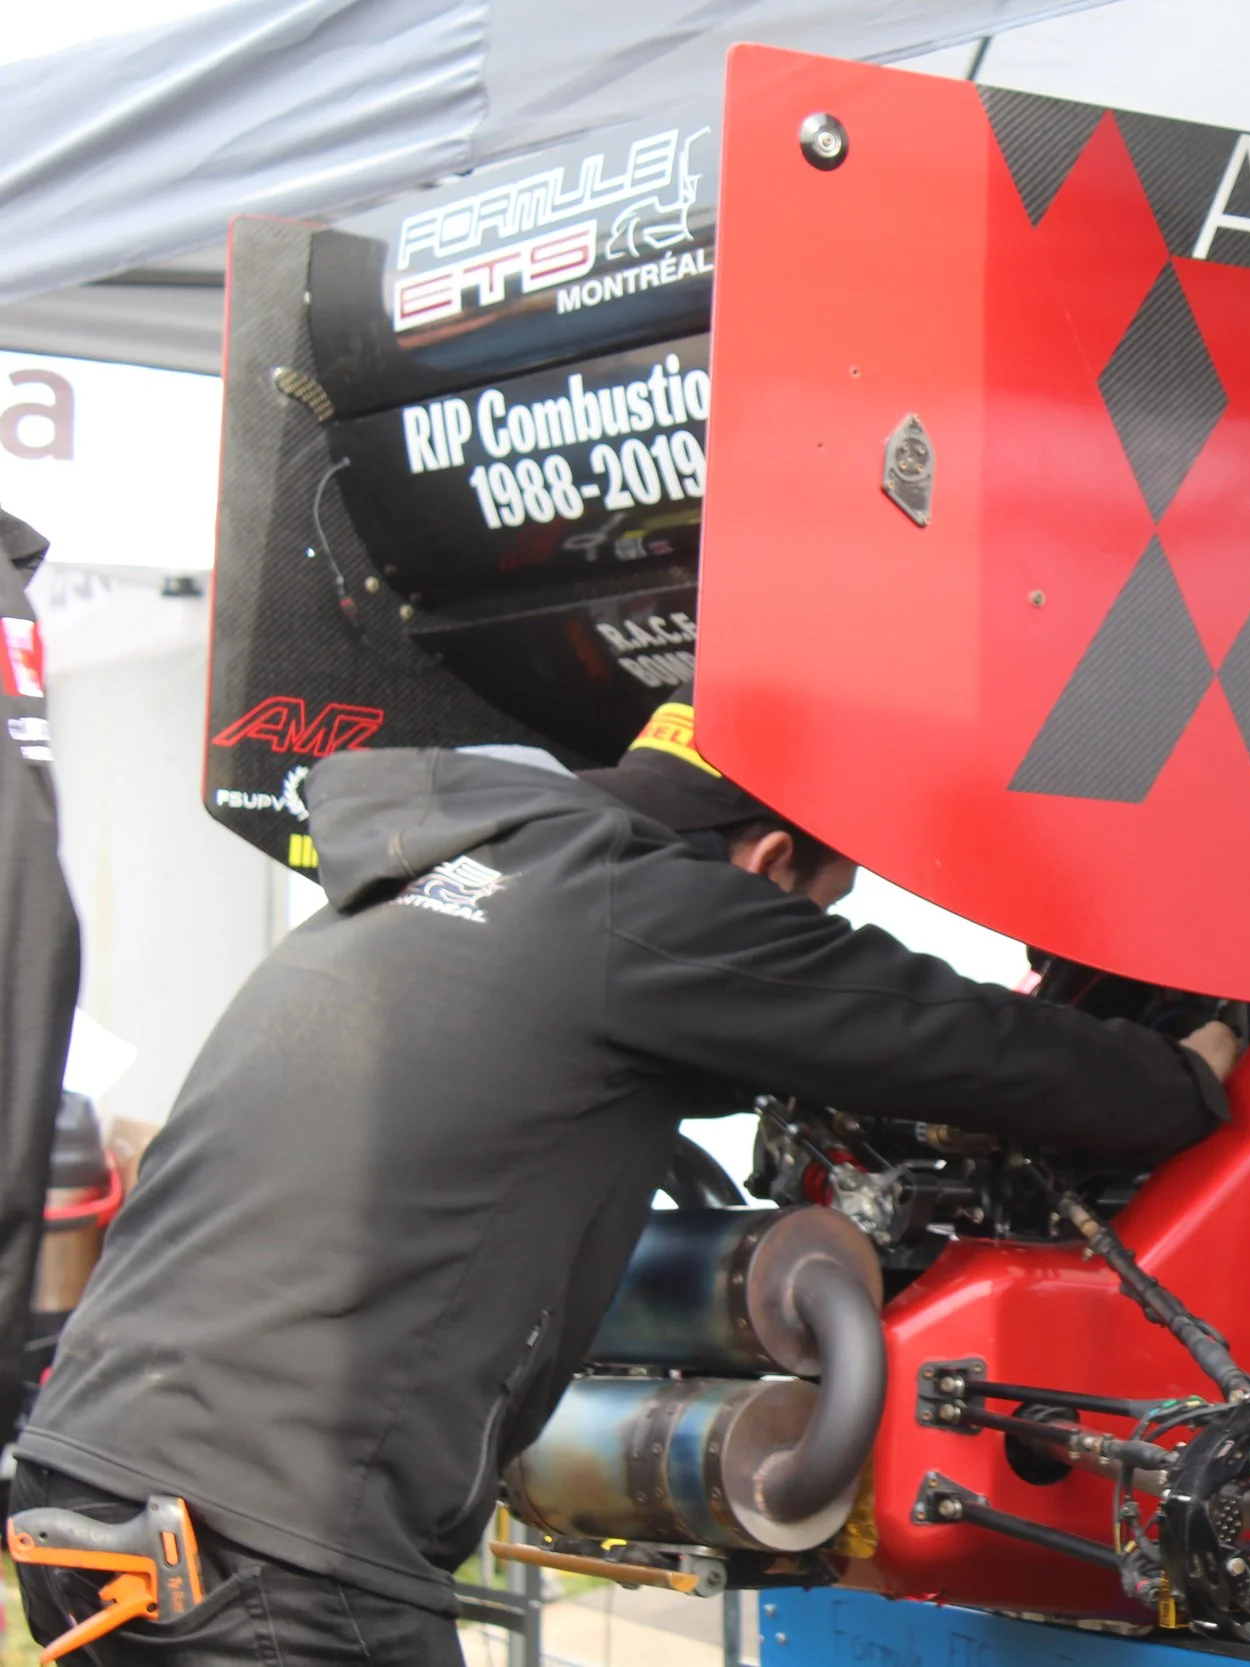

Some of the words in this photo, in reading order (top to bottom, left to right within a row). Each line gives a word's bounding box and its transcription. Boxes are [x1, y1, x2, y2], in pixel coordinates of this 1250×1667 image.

[397, 128, 680, 270] FORMULE
[394, 219, 598, 333] ETS
[557, 249, 714, 315] MONTRÉAL
[402, 398, 472, 474] RIP
[477, 353, 710, 458] Combustio
[469, 430, 707, 529] 1988-2019
